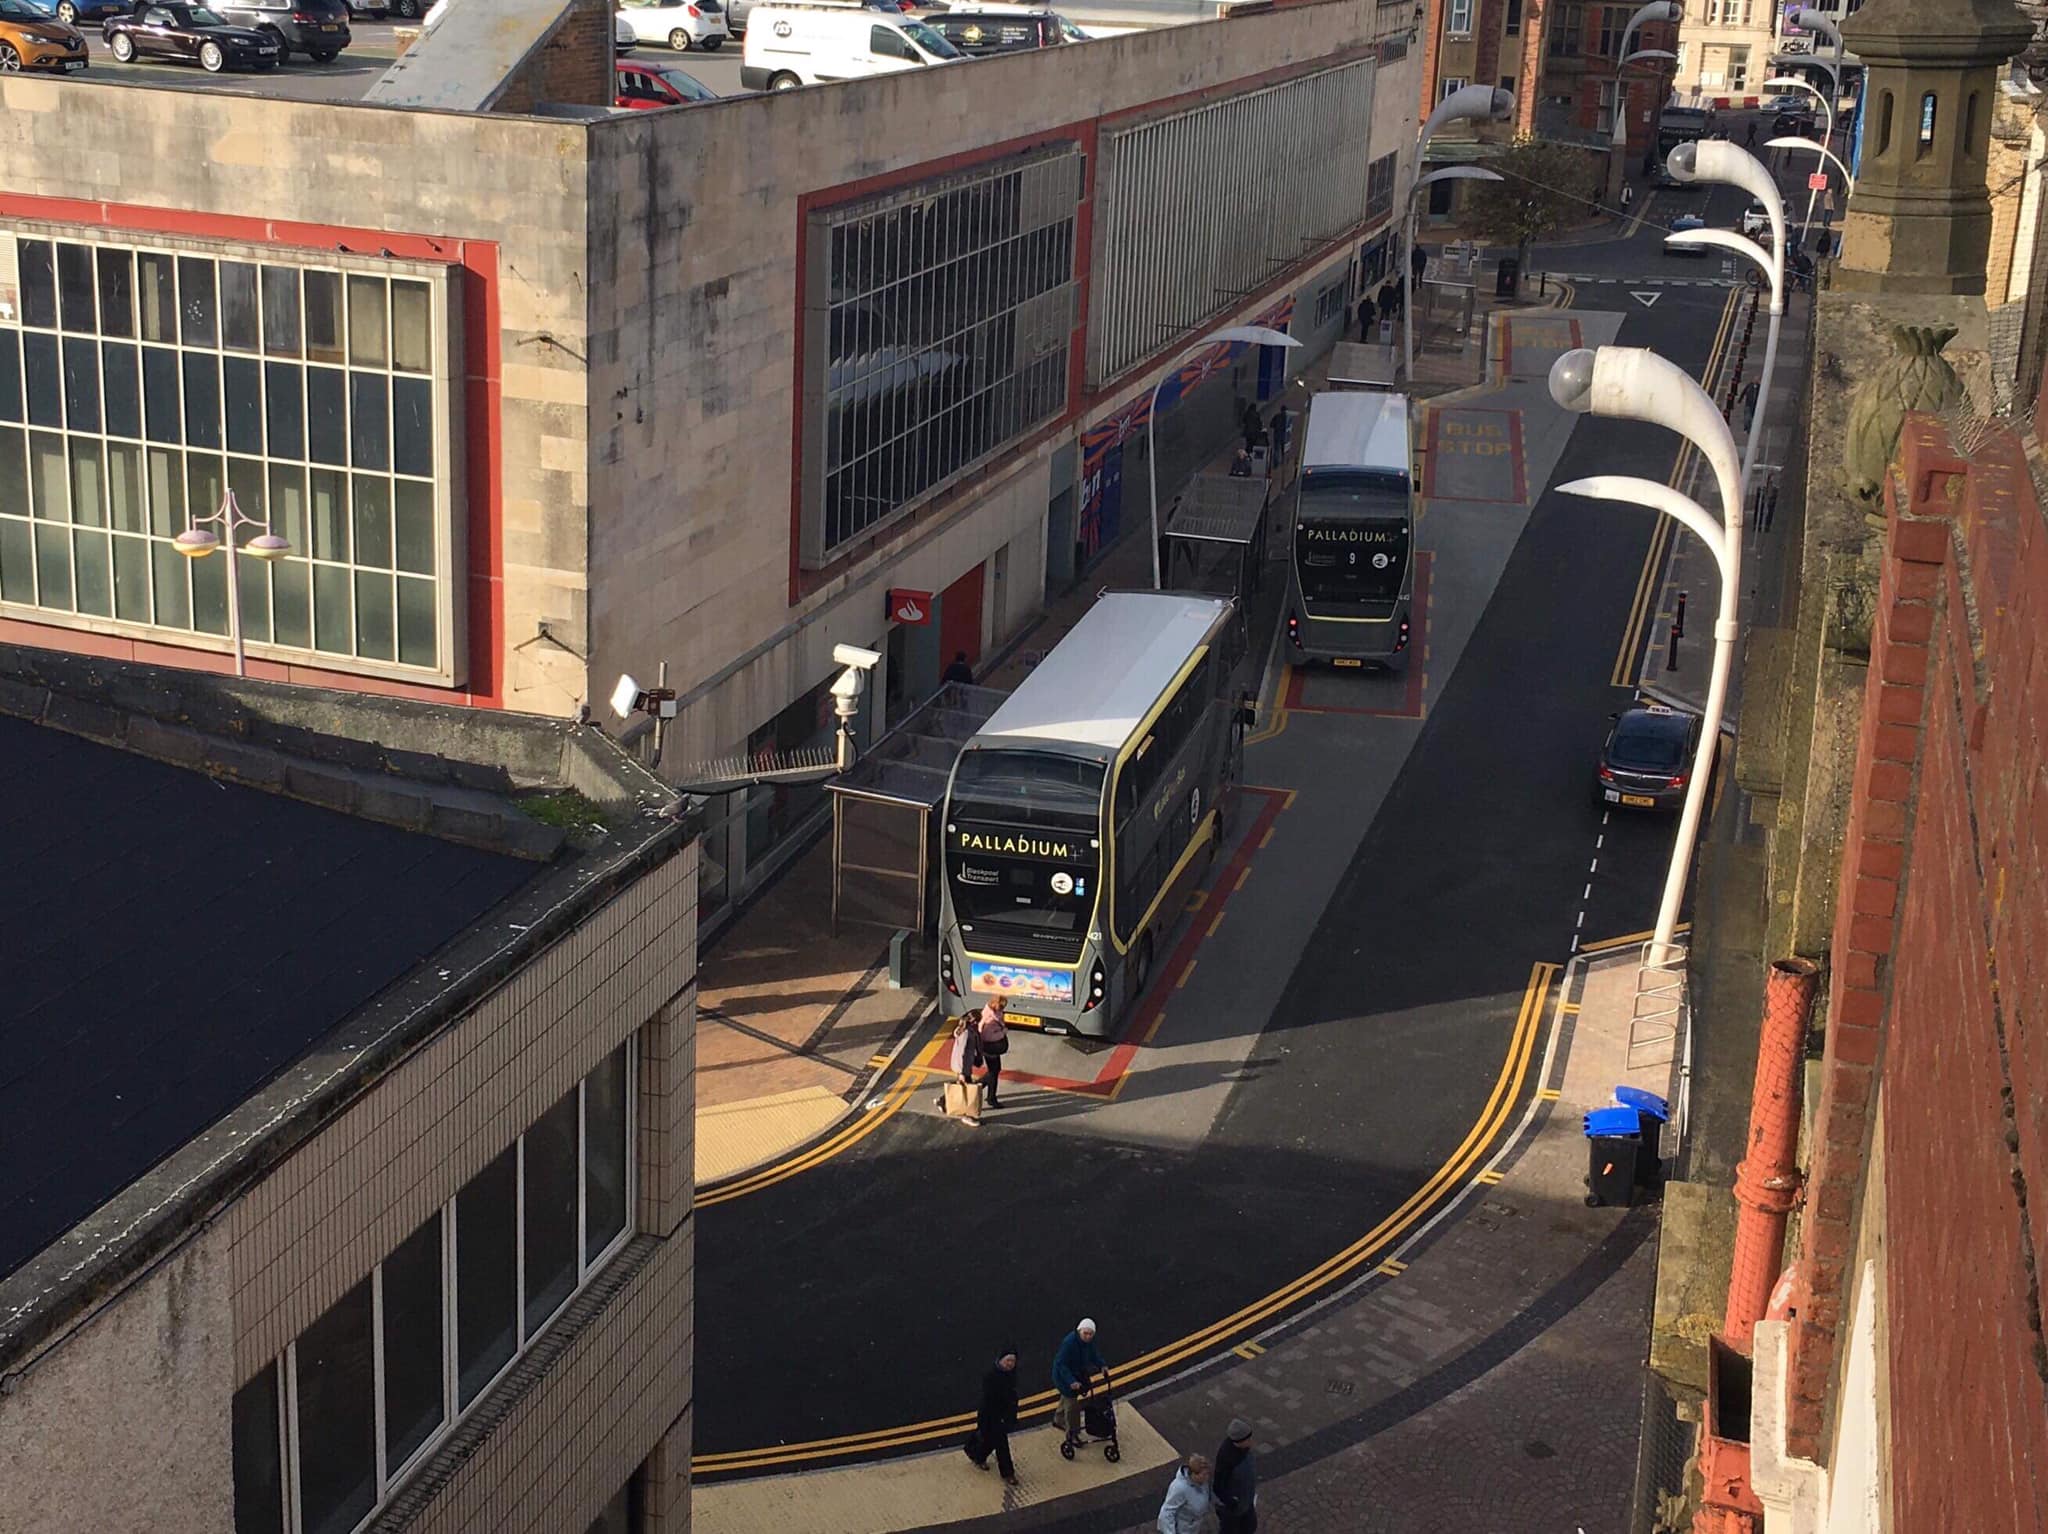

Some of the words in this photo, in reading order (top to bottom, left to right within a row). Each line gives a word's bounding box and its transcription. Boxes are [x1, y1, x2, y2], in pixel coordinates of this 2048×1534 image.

[1446, 422, 1502, 437] BUS
[1438, 441, 1512, 456] STOP
[1308, 529, 1386, 543] PALLADIUM
[1349, 552, 1356, 565] 9
[961, 833, 1068, 858] PALLADIUM
